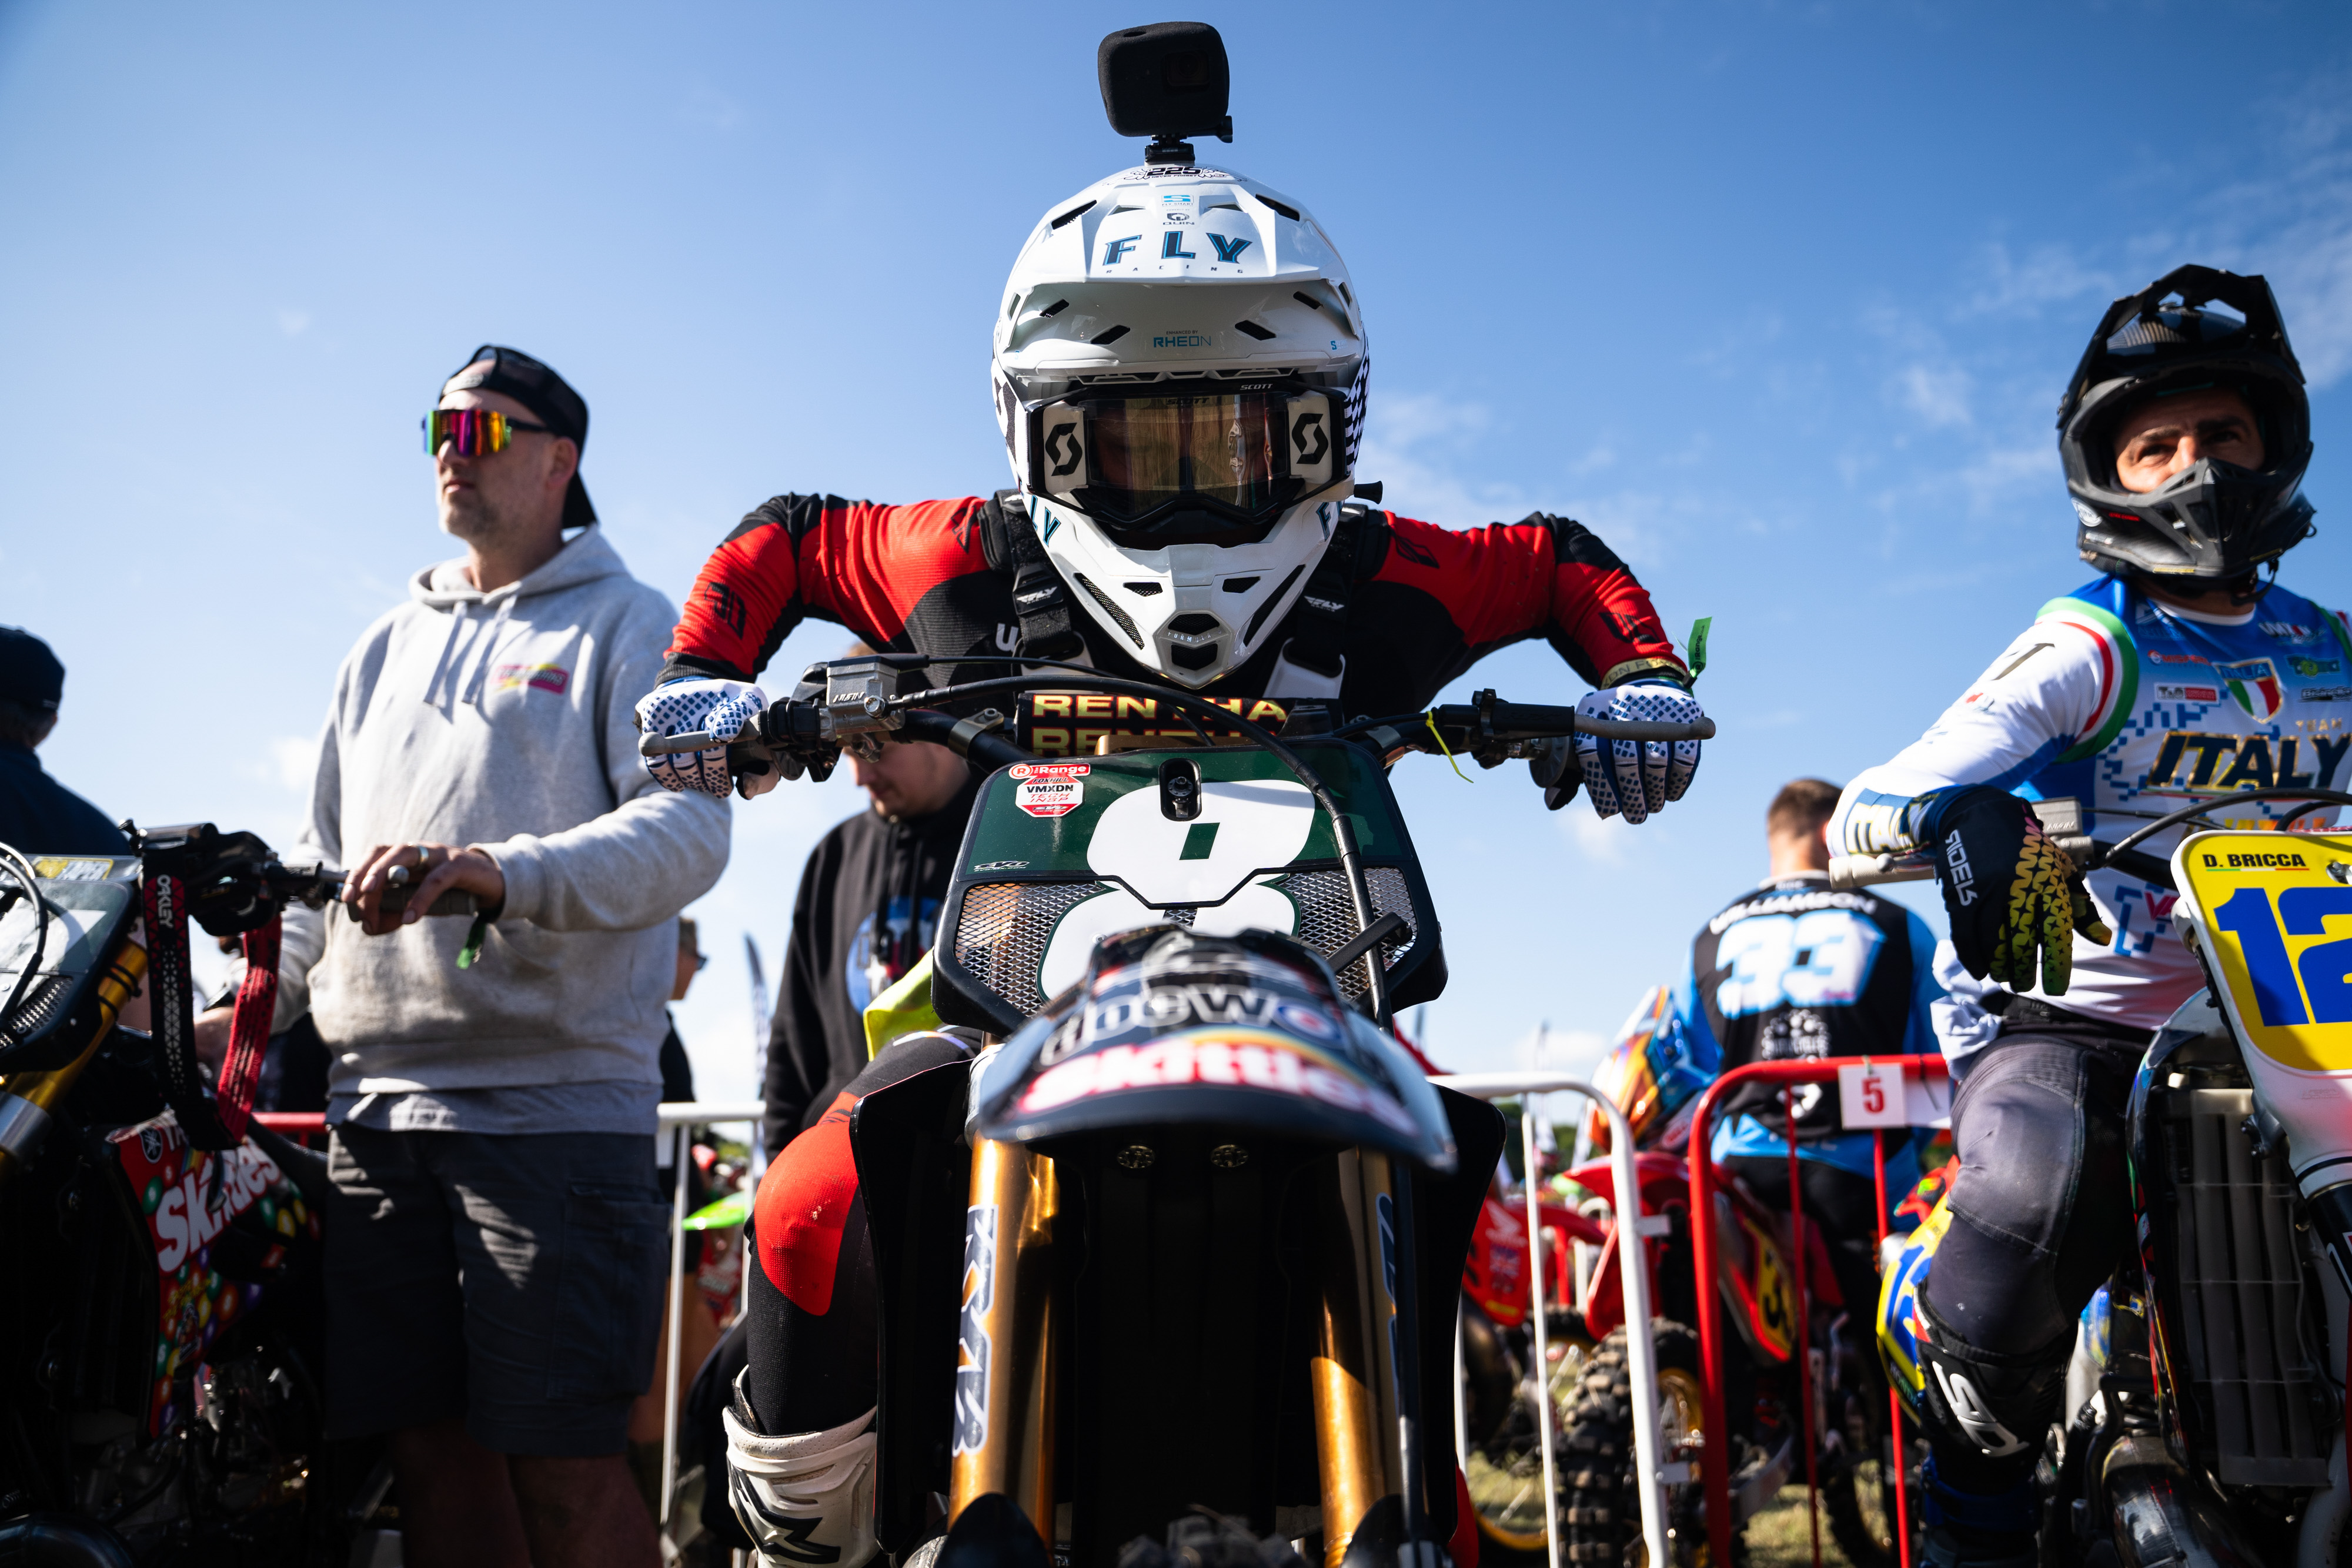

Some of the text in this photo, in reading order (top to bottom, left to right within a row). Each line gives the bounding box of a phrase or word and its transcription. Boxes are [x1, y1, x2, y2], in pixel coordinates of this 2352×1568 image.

[1146, 166, 1203, 176] 225
[1102, 230, 1253, 266] FLY
[1106, 264, 1244, 274] RACING
[1153, 335, 1211, 348] RHEON
[1033, 695, 1289, 722] RENHA
[2295, 717, 2343, 733] TEAM
[2146, 731, 2352, 791] ITALY
[1039, 766, 1087, 774] Range
[1027, 785, 1074, 793] VMXDN
[2202, 854, 2306, 867] D. BRICCA
[157, 874, 173, 929] OAKLEY
[1716, 910, 1886, 1020] 33
[1862, 1078, 1885, 1114] 5
